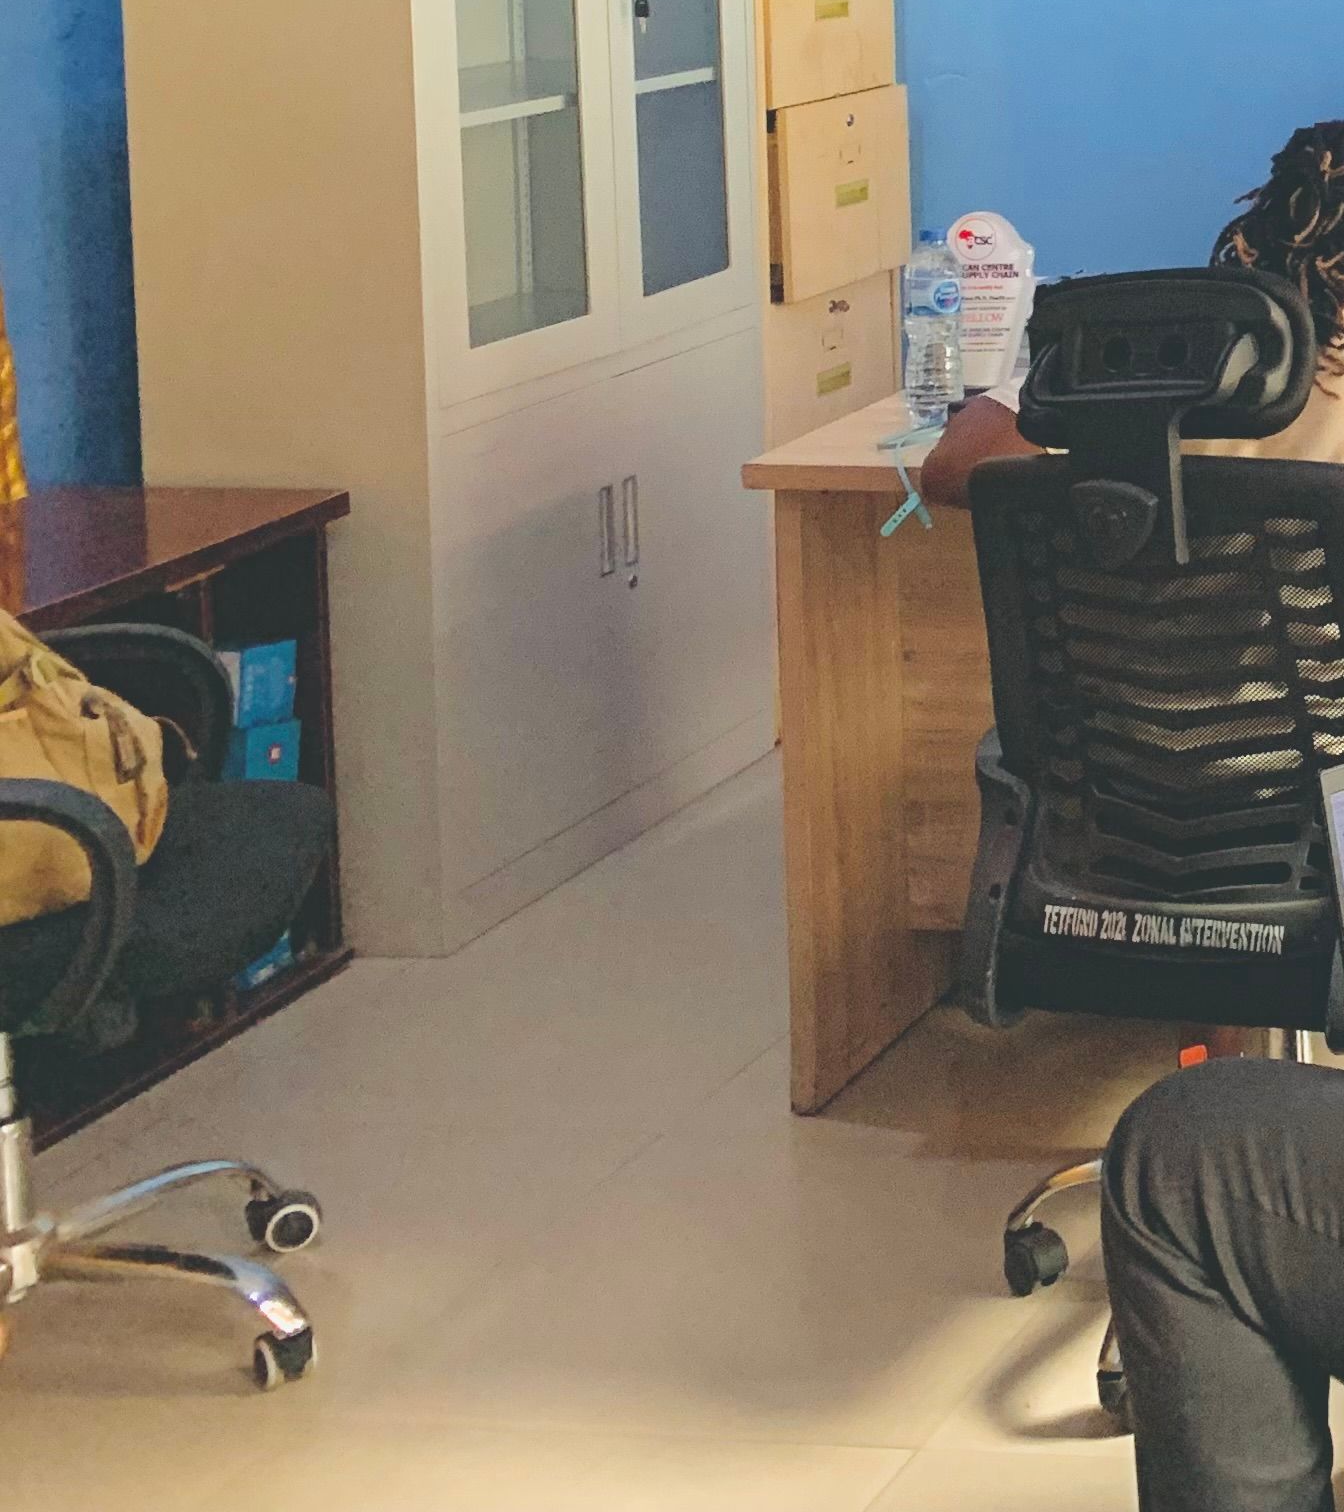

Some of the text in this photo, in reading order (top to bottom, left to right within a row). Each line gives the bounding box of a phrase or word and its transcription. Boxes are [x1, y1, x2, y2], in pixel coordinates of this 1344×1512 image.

[1043, 904, 1099, 937] TETFUND
[1131, 913, 1176, 945] ZONAL
[1179, 917, 1285, 955] INTERVENTION
